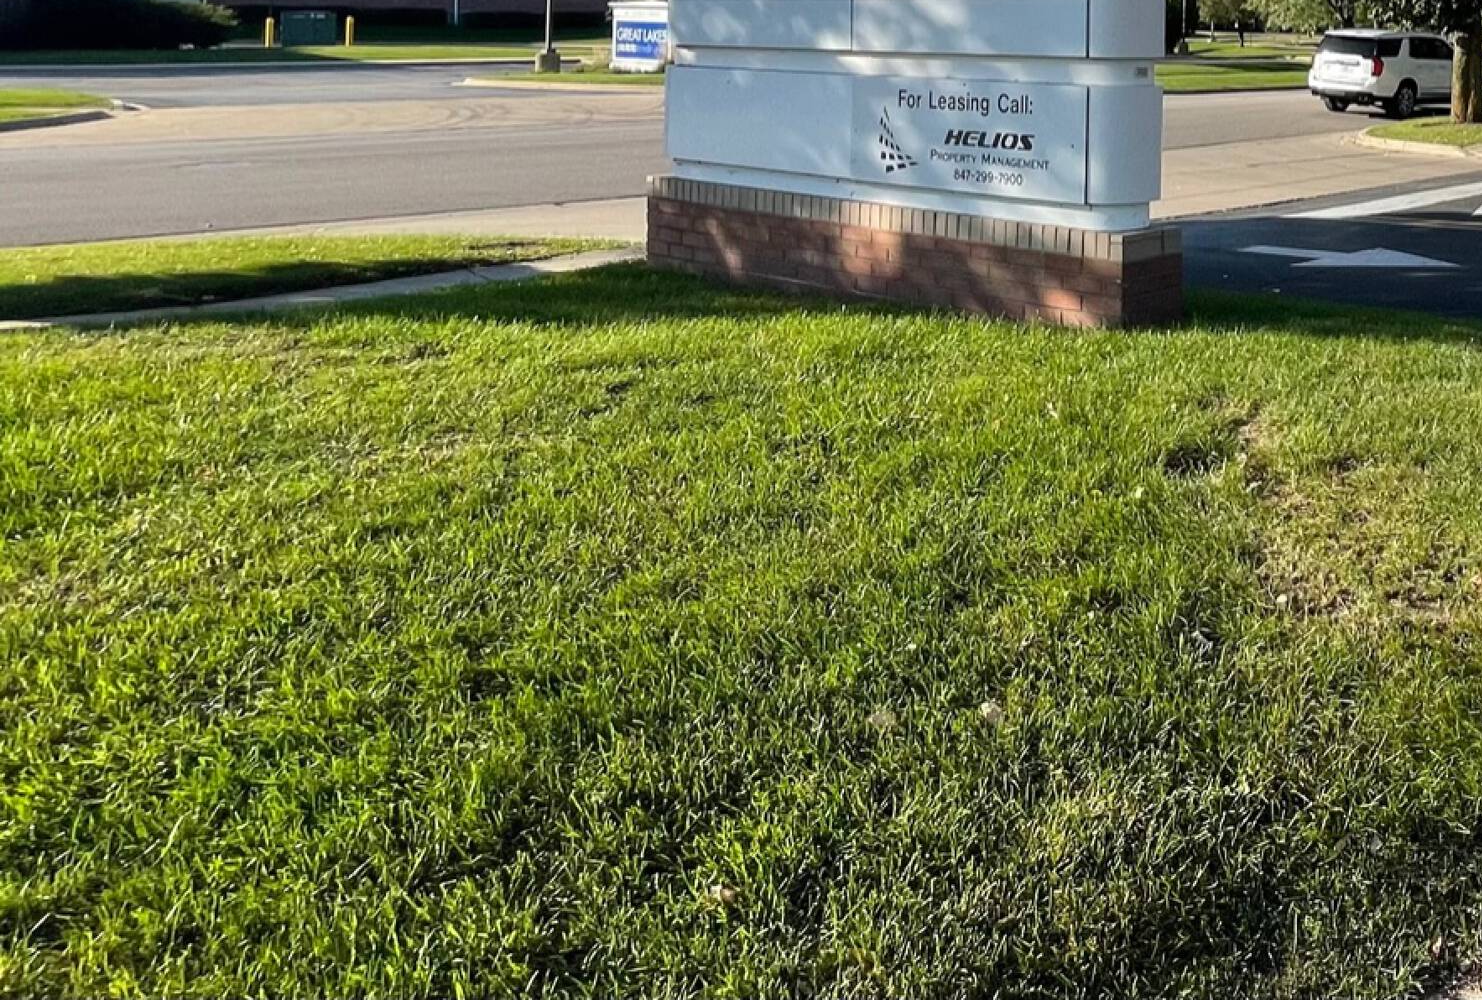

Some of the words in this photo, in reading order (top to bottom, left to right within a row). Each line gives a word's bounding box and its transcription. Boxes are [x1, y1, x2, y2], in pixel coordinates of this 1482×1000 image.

[617, 27, 641, 42] GREAT
[898, 89, 922, 109] For
[929, 91, 989, 117] Leasing
[997, 94, 1033, 116] Call:
[944, 129, 1035, 151] HELIOS
[930, 149, 977, 164] PROPERTY
[981, 153, 1049, 171] MANAGEMENT
[954, 168, 1023, 186] 847-299-7900
